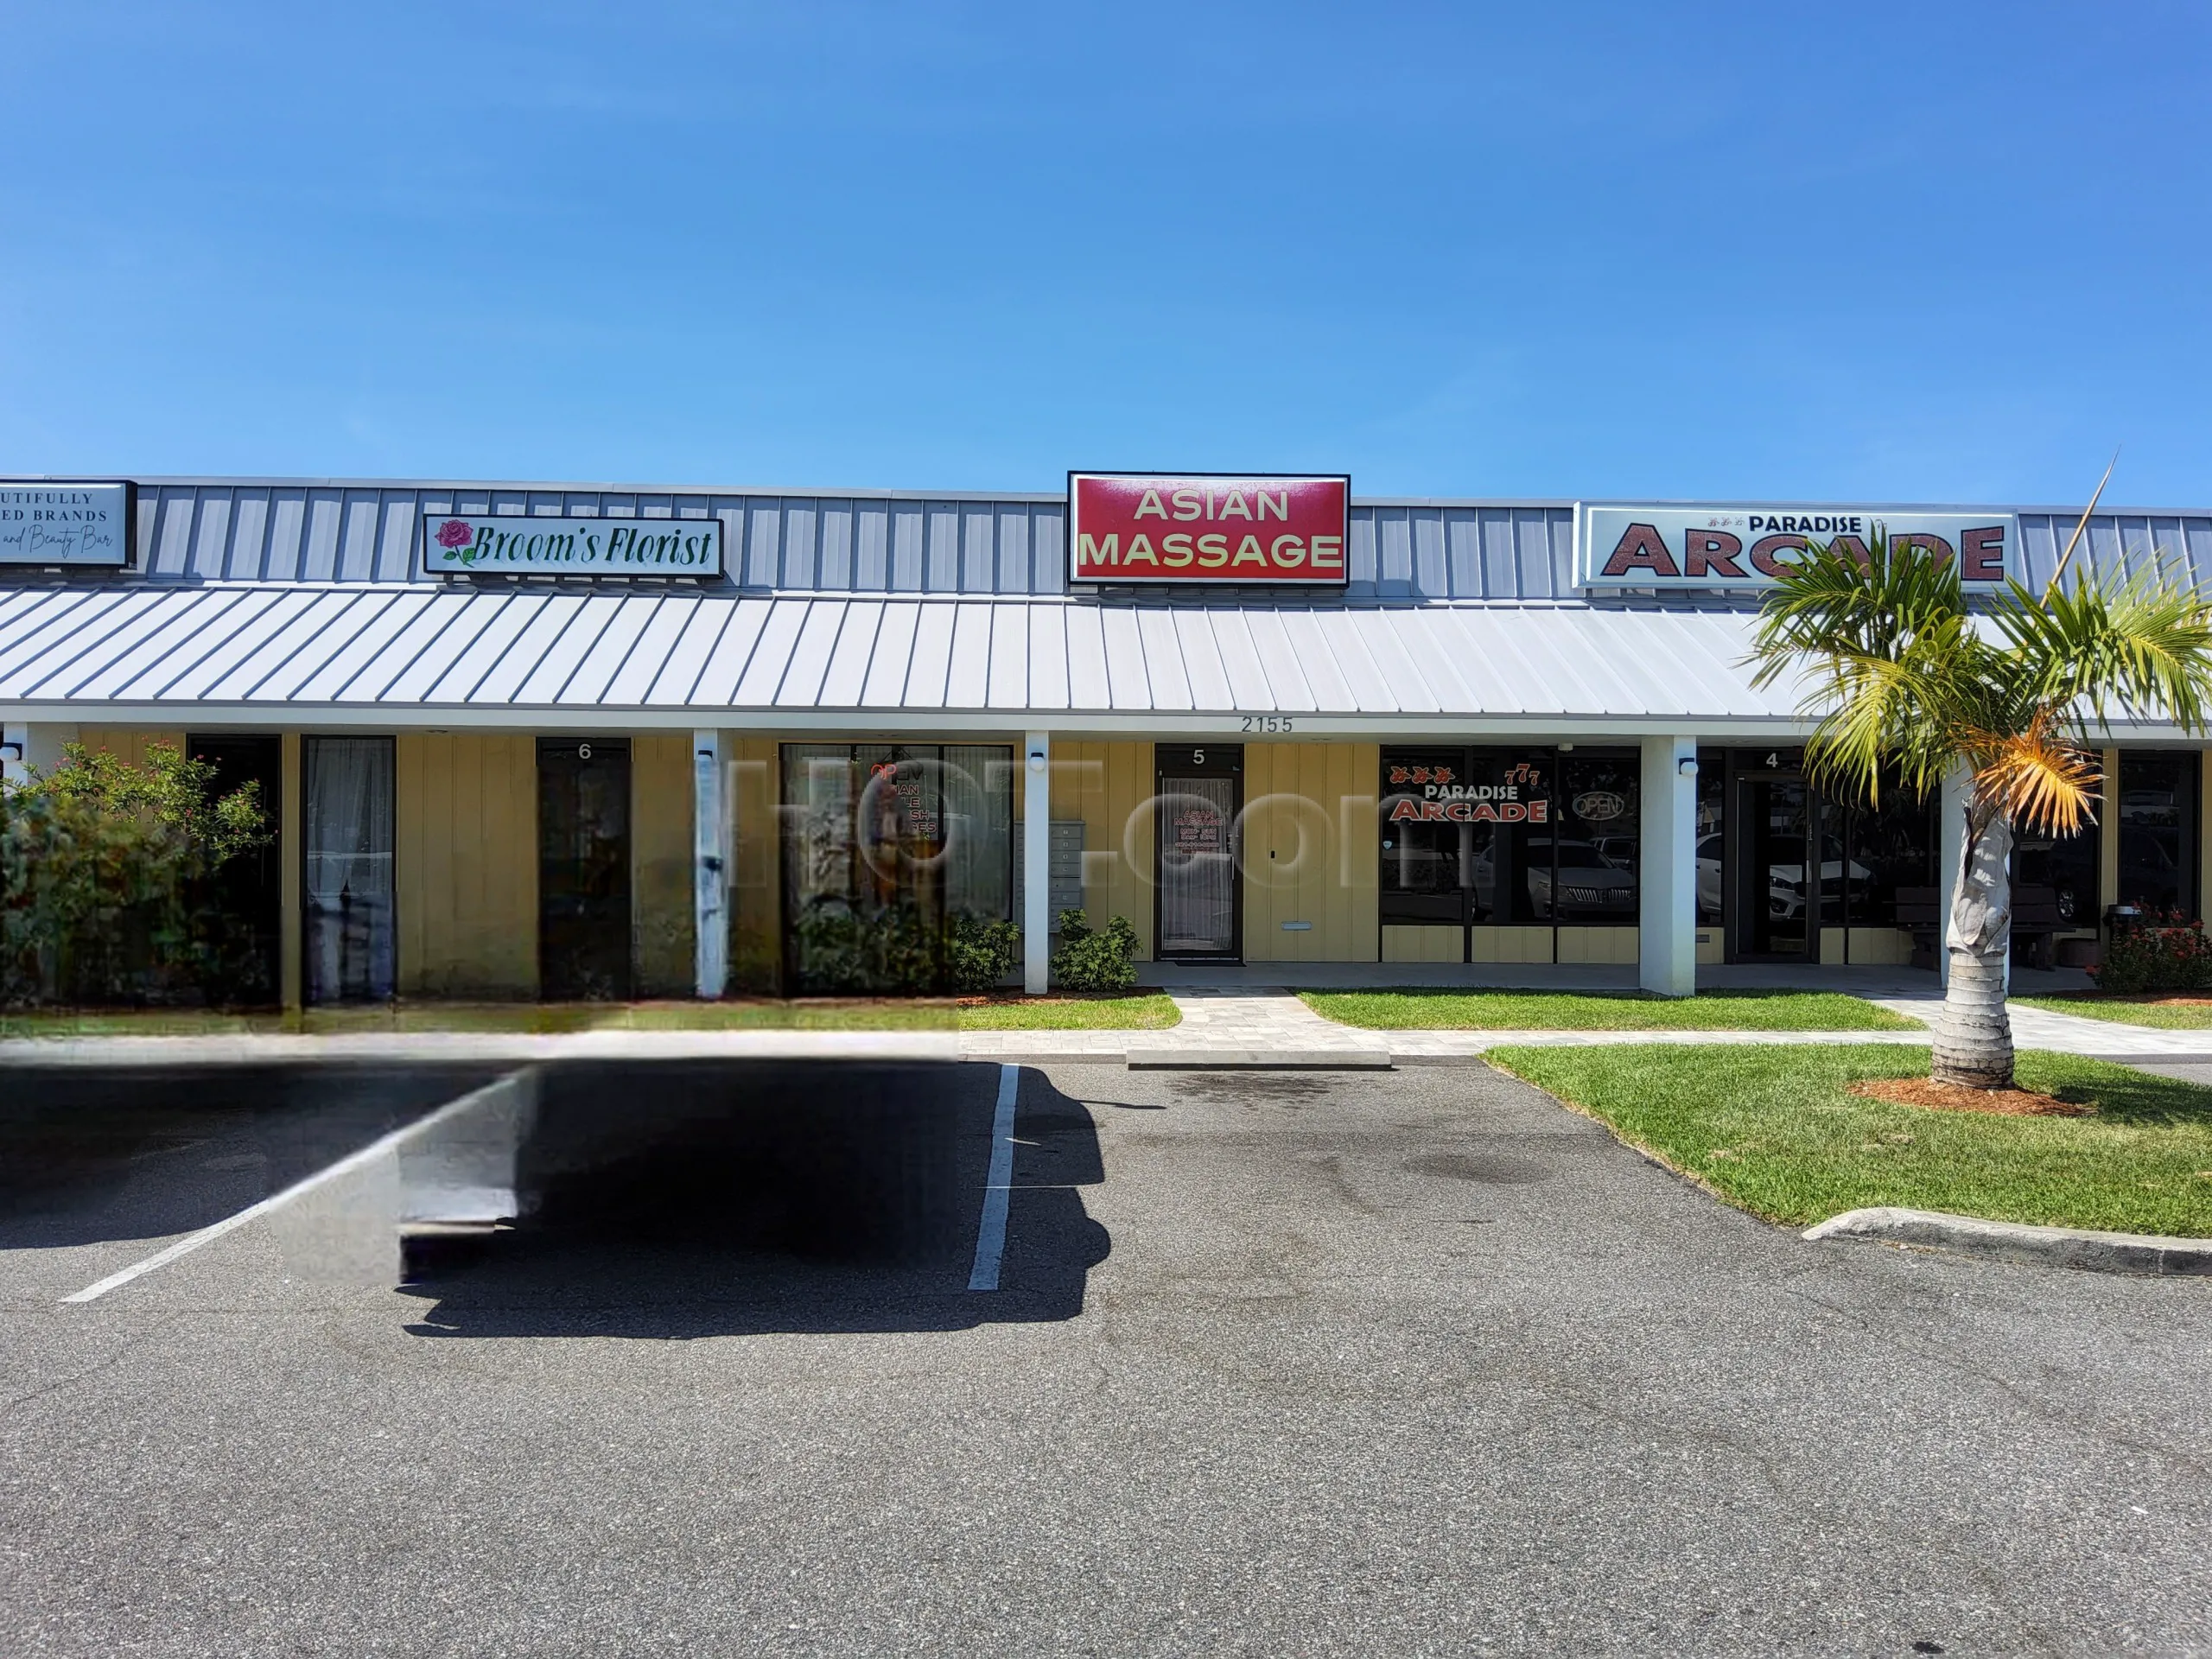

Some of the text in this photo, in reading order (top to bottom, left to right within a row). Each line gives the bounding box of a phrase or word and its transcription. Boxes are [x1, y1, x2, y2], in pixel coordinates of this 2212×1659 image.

[1133, 489, 1288, 522] ASIAN
[34, 510, 106, 522] BRANDS
[1749, 516, 1862, 533] PARADISE
[3, 524, 112, 559] and Beauty Bar
[474, 526, 712, 565] Broom's Florist
[1078, 533, 1343, 569] MASSAGE
[1242, 716, 1293, 733] 2155
[579, 743, 591, 759] 6
[1192, 749, 1205, 765] 5
[1766, 753, 1778, 767] 4
[1425, 785, 1518, 800] PARADISE
[1389, 799, 1548, 823] ARCADE
[1575, 795, 1623, 814] OPEN
[1174, 817, 1224, 826] MASSAGE
[1184, 810, 1214, 818] ASIAN
